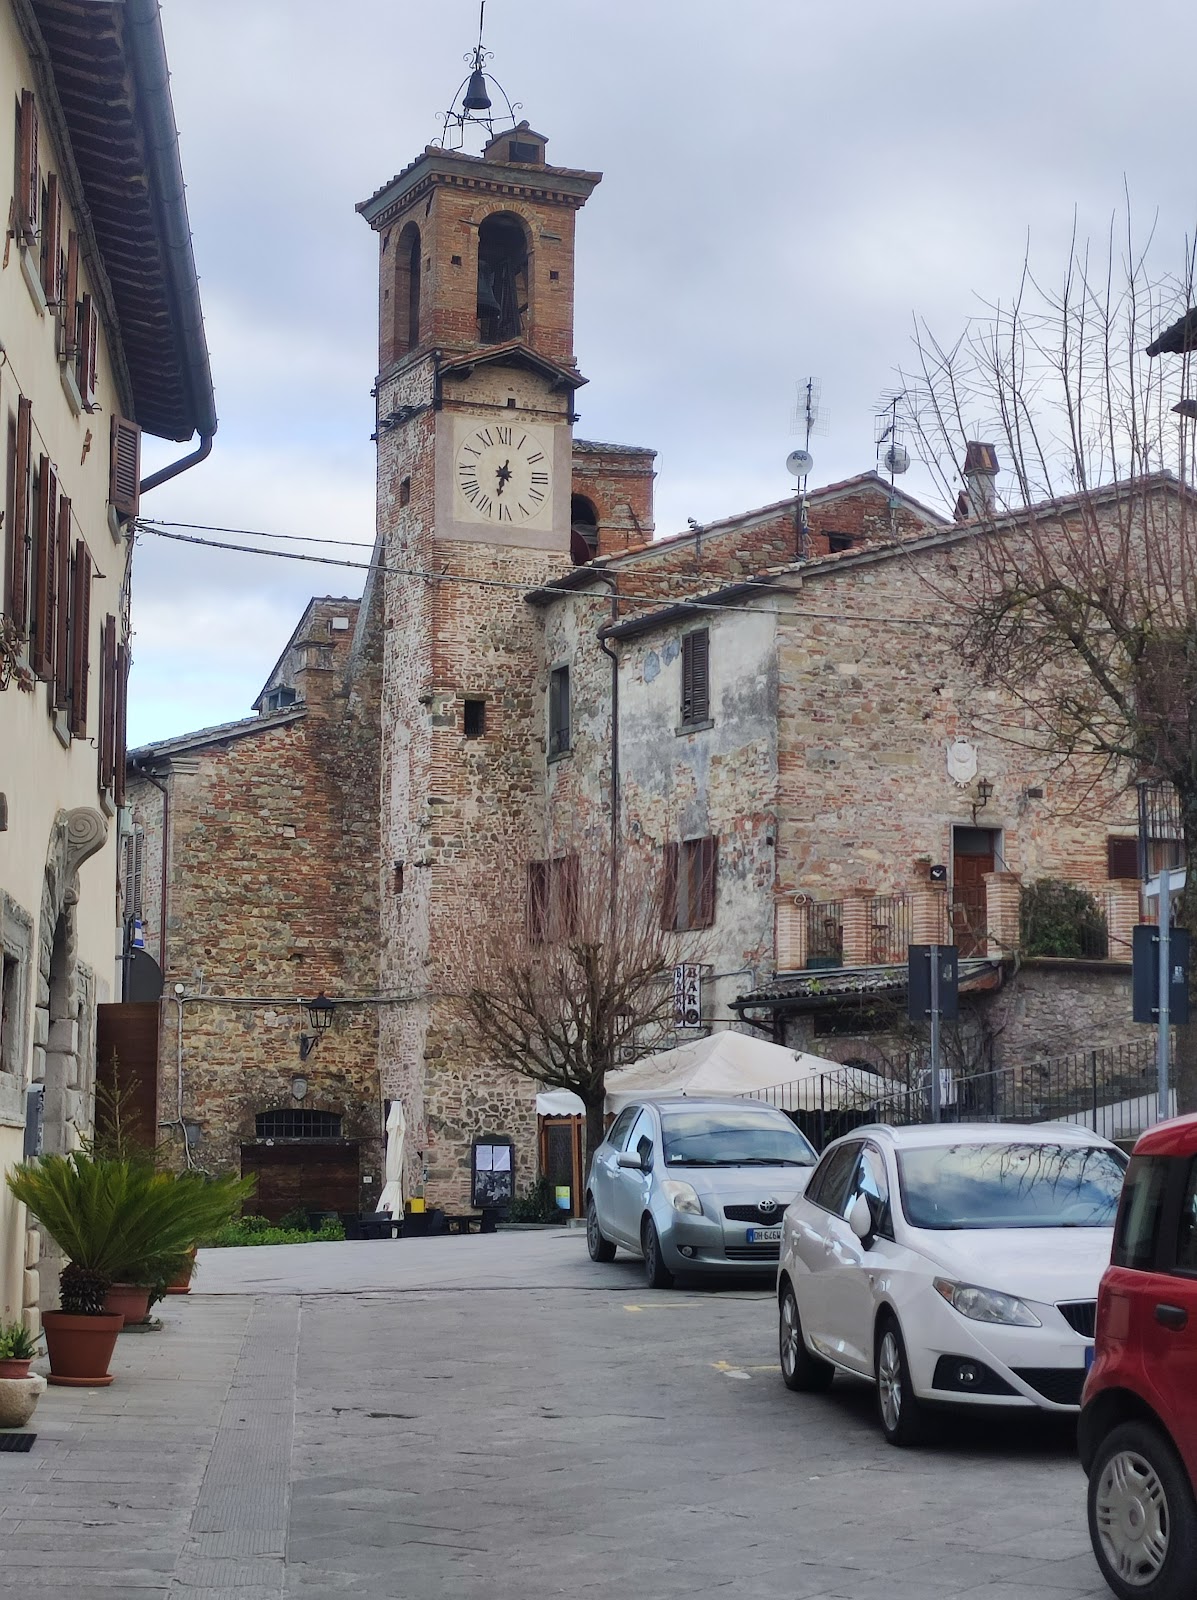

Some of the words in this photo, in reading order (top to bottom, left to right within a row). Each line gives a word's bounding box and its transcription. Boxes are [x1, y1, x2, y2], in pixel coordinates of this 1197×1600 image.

[476, 428, 494, 449] XI
[496, 427, 511, 446] XII
[517, 434, 527, 450] I
[464, 444, 481, 459] X
[526, 452, 545, 465] II
[459, 462, 477, 476] IX
[531, 471, 549, 485] III
[461, 479, 481, 503] VIII
[528, 487, 545, 507] IV
[475, 494, 493, 518] VII
[498, 503, 513, 521] VI
[517, 502, 530, 518] V
[687, 968, 697, 1005] BAR
